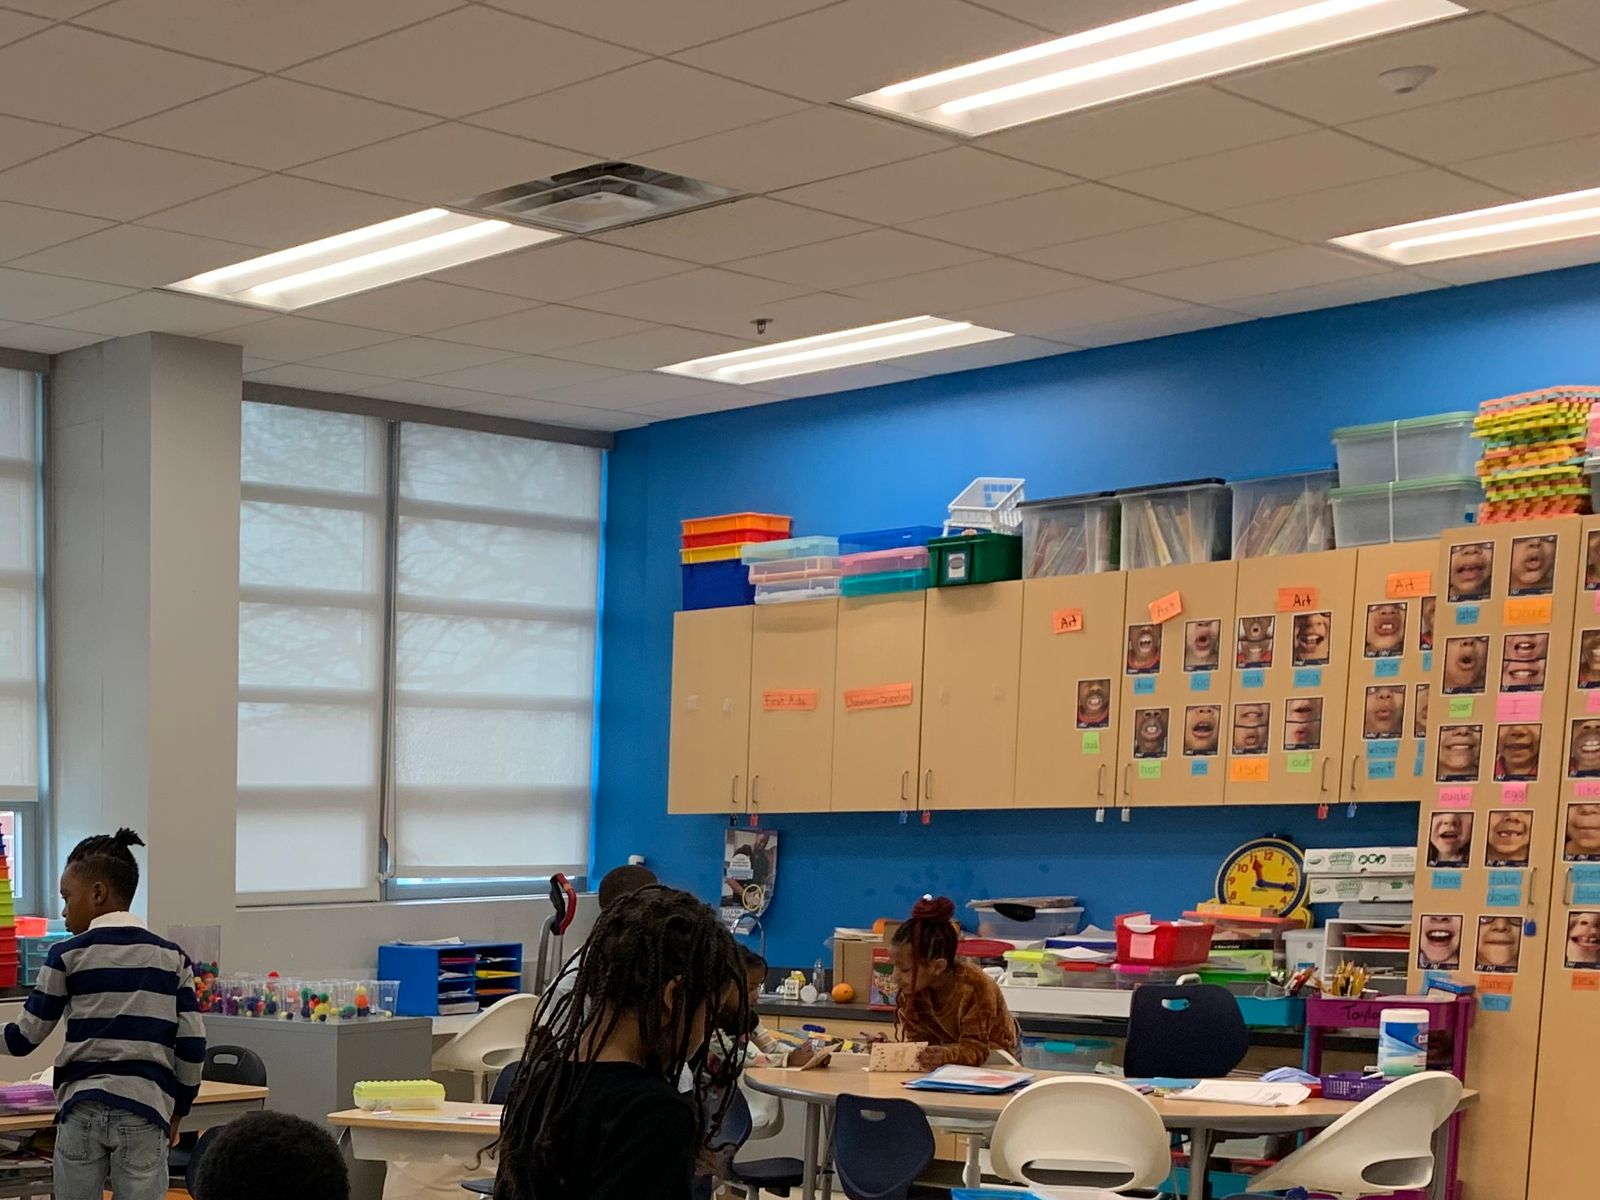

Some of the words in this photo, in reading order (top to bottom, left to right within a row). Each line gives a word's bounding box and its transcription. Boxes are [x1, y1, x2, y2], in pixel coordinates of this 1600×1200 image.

[1394, 578, 1414, 592] Art
[1293, 594, 1312, 607] Art
[1061, 615, 1078, 629] Art
[1263, 850, 1273, 861] 12
[1237, 863, 1249, 874] 10
[1287, 867, 1295, 876] 2
[1228, 876, 1235, 885] 9
[1280, 896, 1288, 905] 4
[1340, 1003, 1381, 1023] Taylo
